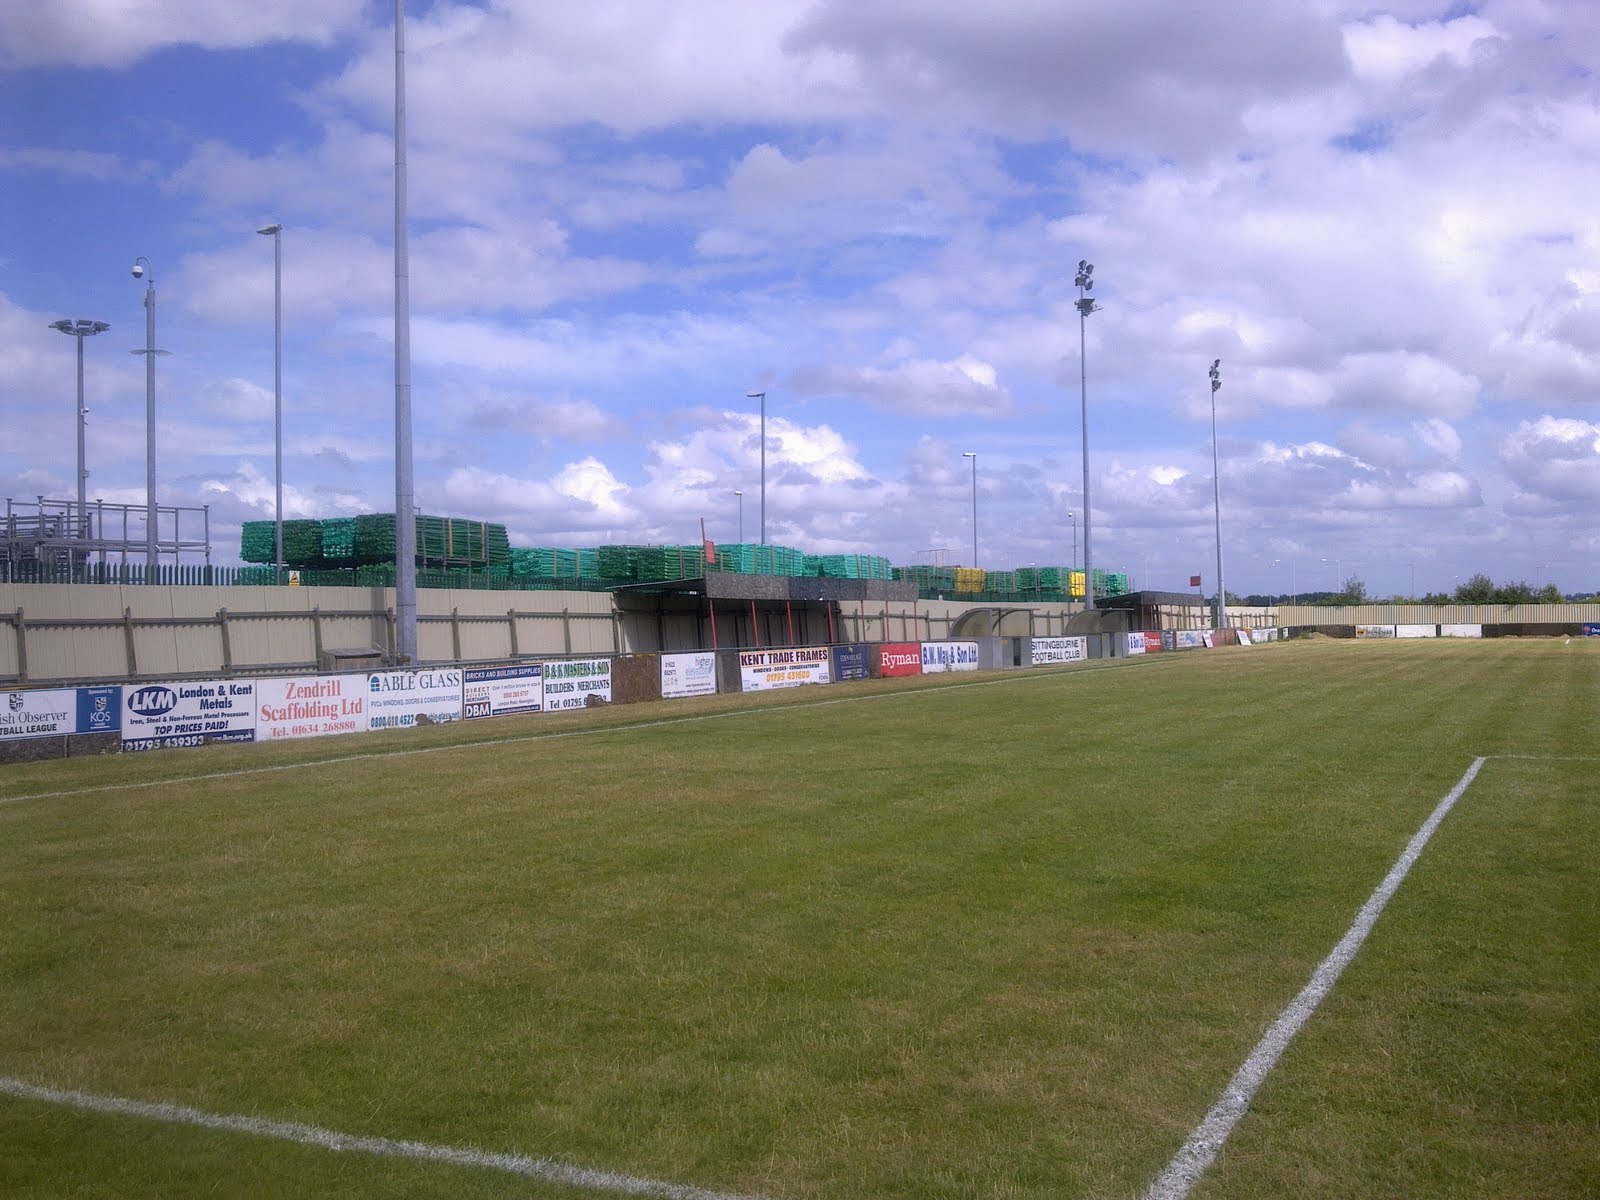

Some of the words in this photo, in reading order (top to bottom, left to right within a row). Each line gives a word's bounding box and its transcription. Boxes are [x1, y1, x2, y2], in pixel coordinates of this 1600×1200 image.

[741, 654, 765, 666] KENT
[768, 651, 794, 664] TRADE
[796, 650, 828, 662] FRAMES
[881, 652, 920, 668] Ryman
[957, 646, 968, 664] Son
[1064, 650, 1080, 660] CLUB
[466, 671, 485, 680] BRICKS
[545, 664, 550, 679] B
[551, 664, 557, 679] &
[557, 664, 563, 678] K
[564, 662, 590, 678] MASTERS
[591, 662, 596, 676] &
[597, 661, 609, 676] SON
[381, 676, 415, 691] ABLE
[420, 672, 460, 689] GLASS
[546, 682, 574, 694] BUILDERS
[578, 679, 610, 691] MERCHANTS
[180, 686, 214, 698] London
[218, 685, 226, 696] &
[230, 684, 252, 696] Kent
[286, 680, 341, 699] Zendrill
[132, 690, 174, 710] LKM
[200, 697, 232, 710] Metals
[550, 700, 559, 709] Tel
[563, 698, 582, 708] 01795
[18, 712, 68, 723] Observer
[90, 711, 110, 722] KOS
[261, 701, 338, 722] Scaffolding
[342, 698, 362, 715] Ltd
[466, 704, 490, 718] DBM
[154, 725, 172, 735] TOP
[175, 722, 202, 734] PRICES
[205, 720, 228, 730] PAID!
[271, 727, 289, 736] Tel.
[292, 724, 318, 735] 01634
[323, 720, 355, 732] 268880
[371, 716, 386, 728] 0800
[400, 714, 414, 725] 4527
[26, 724, 57, 734] LEAGUE
[124, 740, 160, 751] 01795
[164, 735, 204, 748] 439393
